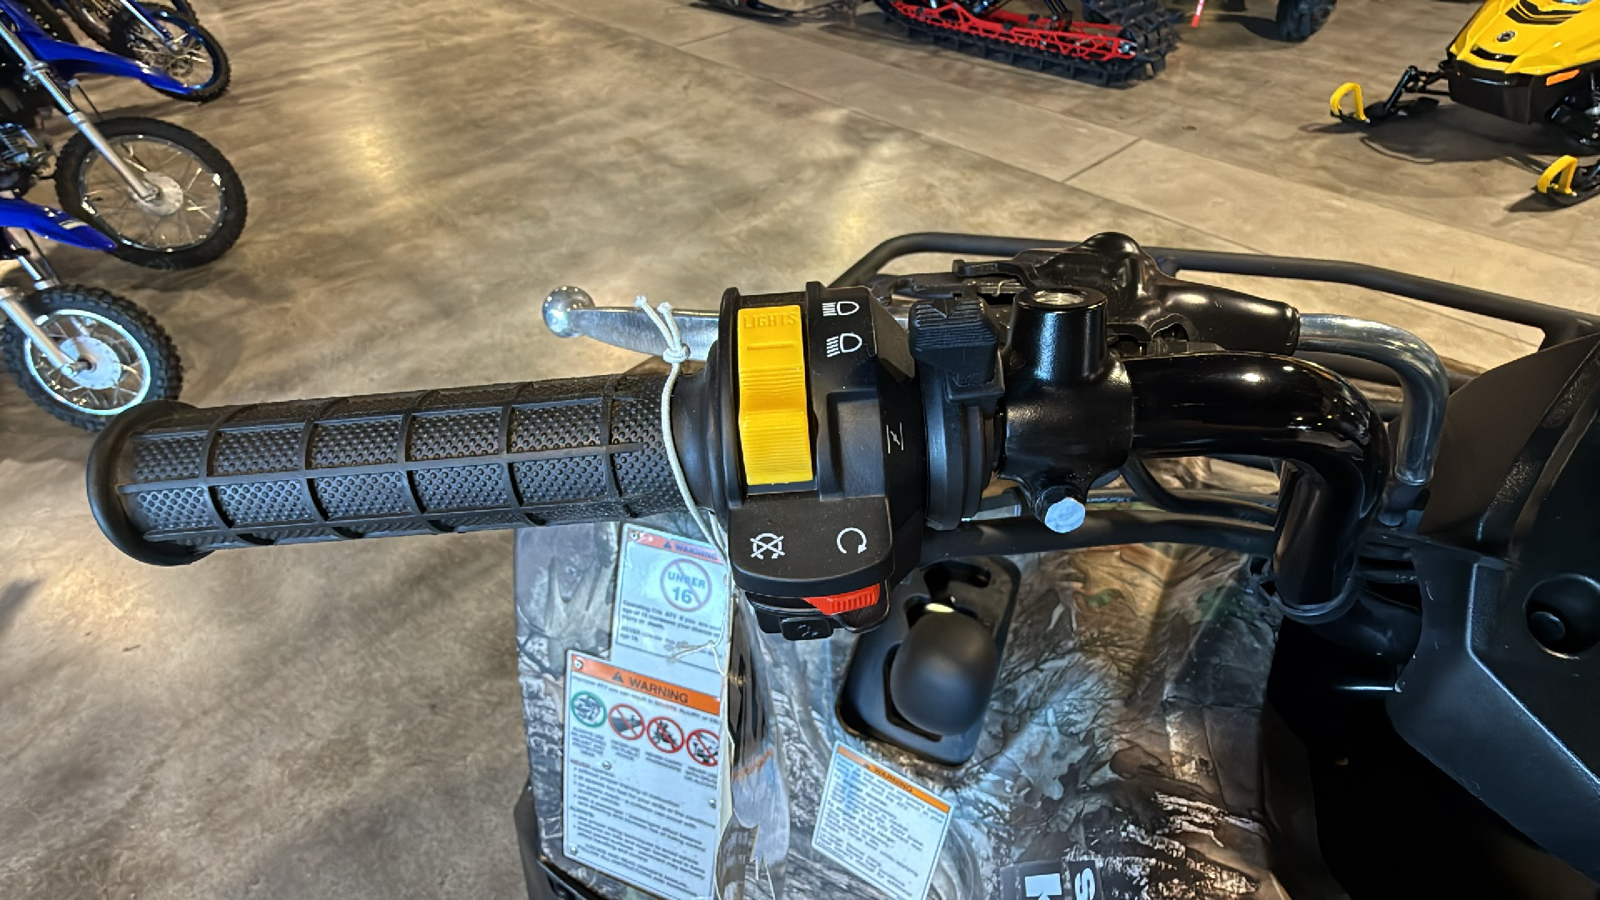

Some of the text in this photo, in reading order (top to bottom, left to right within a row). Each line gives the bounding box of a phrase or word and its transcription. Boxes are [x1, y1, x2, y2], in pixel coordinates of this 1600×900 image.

[743, 312, 798, 329] LIGHTS
[674, 543, 719, 561] WARNING
[667, 571, 706, 590] UNDER
[672, 586, 693, 605] 16
[628, 675, 690, 705] WARNING
[874, 766, 914, 794] WARNING
